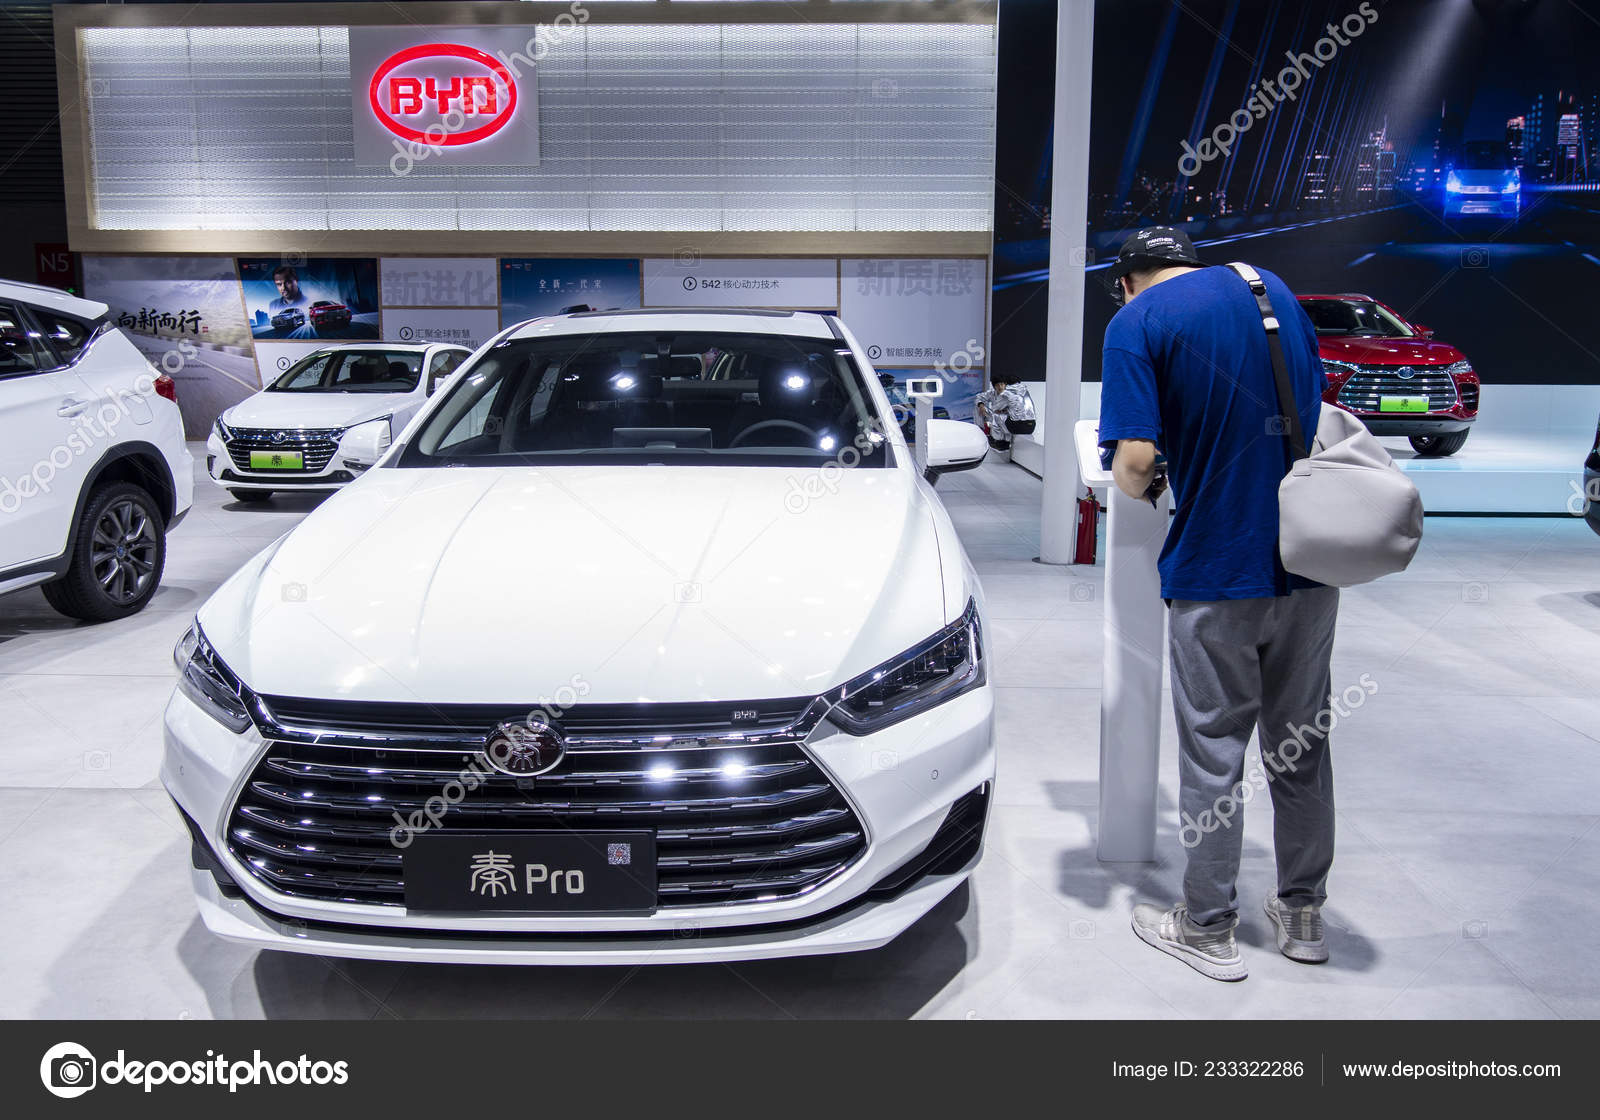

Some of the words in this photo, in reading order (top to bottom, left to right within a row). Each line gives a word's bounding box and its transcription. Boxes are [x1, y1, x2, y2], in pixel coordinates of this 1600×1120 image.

[390, 77, 498, 115] BYD
[41, 252, 70, 273] N5
[383, 270, 497, 305] 新进化
[702, 280, 721, 289] 542
[723, 279, 780, 290] 核心动力技术
[857, 259, 975, 296] 新质感
[118, 307, 203, 334] 向新而行
[886, 347, 943, 358] 智能服务系统
[734, 710, 757, 720] BYD
[526, 863, 585, 894] Pro
